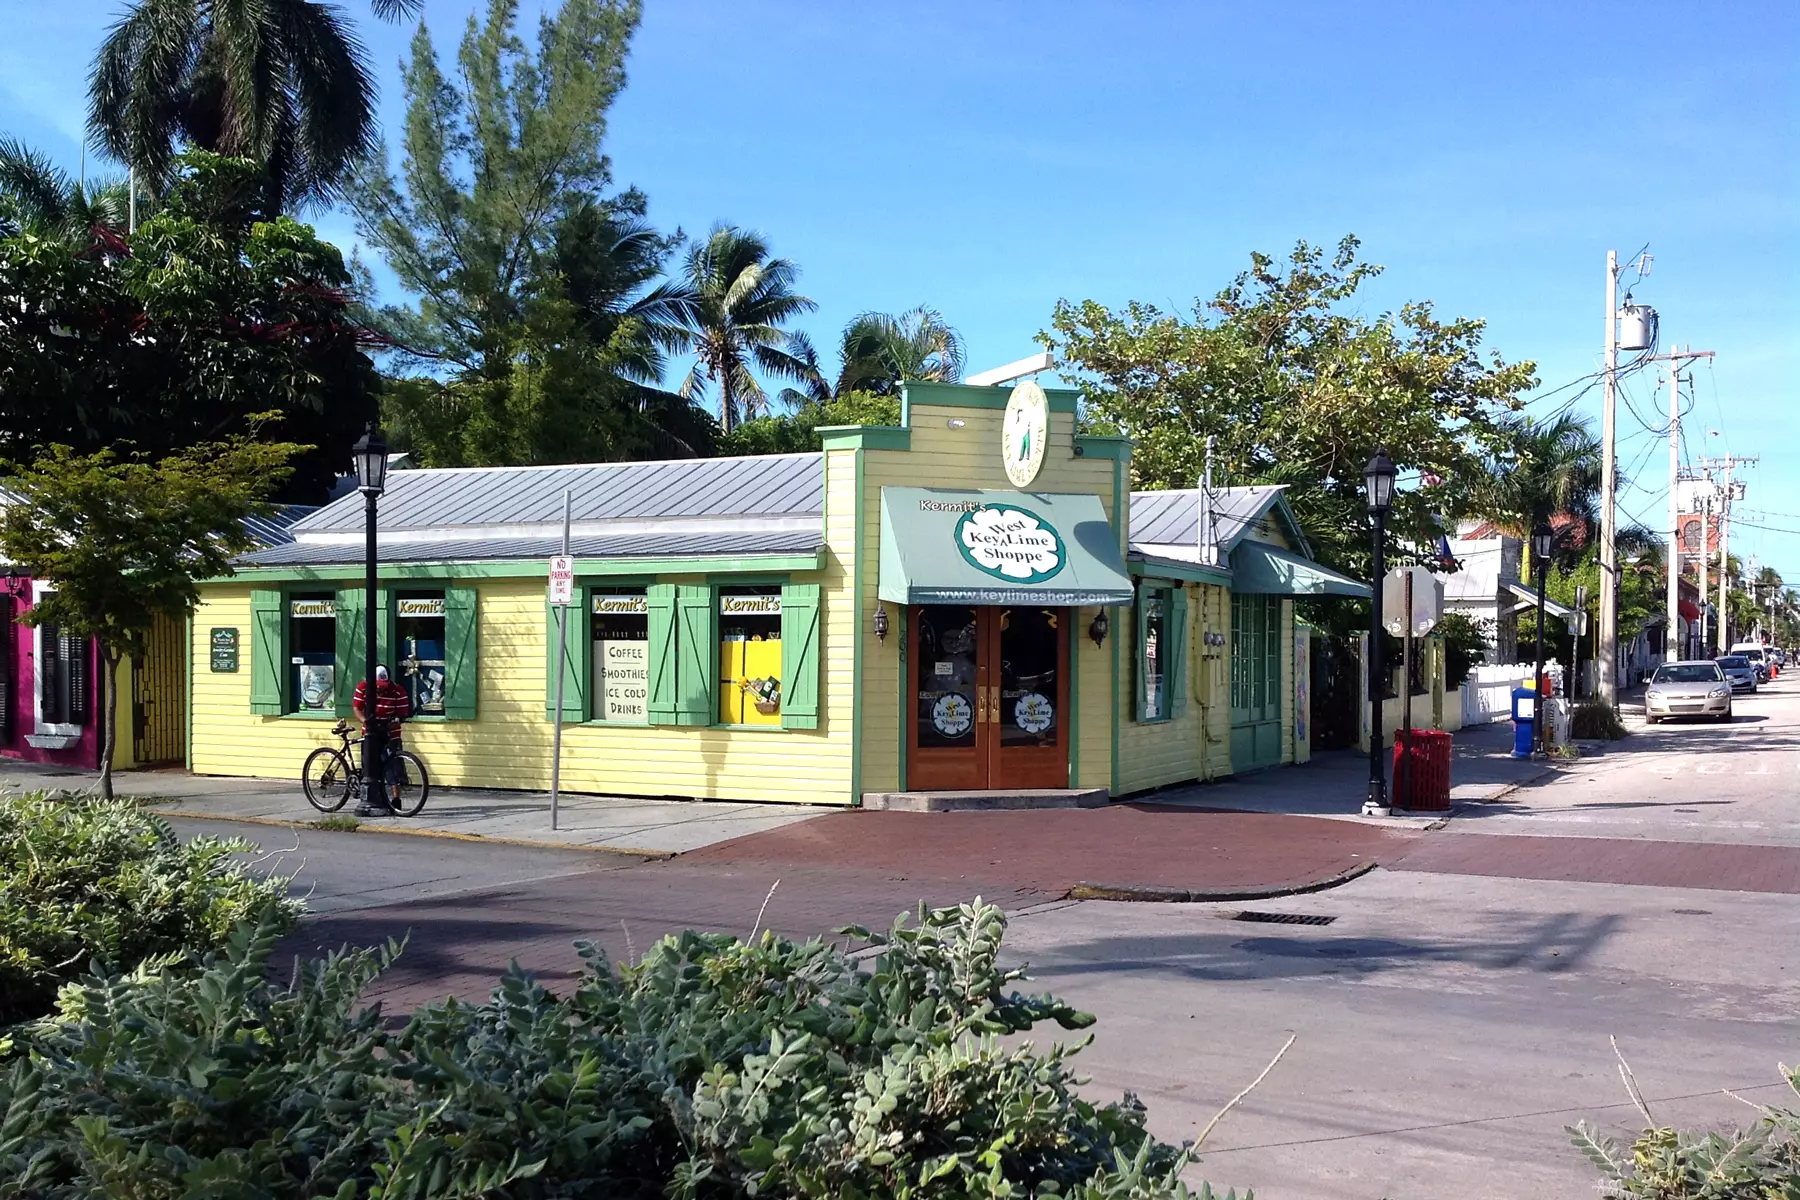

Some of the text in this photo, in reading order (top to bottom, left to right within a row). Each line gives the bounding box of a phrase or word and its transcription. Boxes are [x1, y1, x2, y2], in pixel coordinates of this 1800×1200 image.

[919, 500, 987, 513] Kermit's
[988, 520, 1026, 534] West
[970, 532, 1048, 546] Key Lime
[984, 547, 1043, 563] Shoppe
[557, 559, 566, 569] NO
[552, 571, 571, 579] PARKING
[936, 587, 1110, 604] www.keylimeshop.com
[292, 601, 336, 615] Kermit's
[399, 600, 445, 614] Kermit's
[595, 598, 648, 612] Kermit's
[724, 597, 780, 612] Kermit's
[609, 647, 643, 659] COFFEE
[601, 668, 649, 679] SMOOTHIES
[605, 688, 647, 698] ICE COLD
[611, 703, 642, 715] DRINKS
[1650, 761, 1800, 775] TOP
